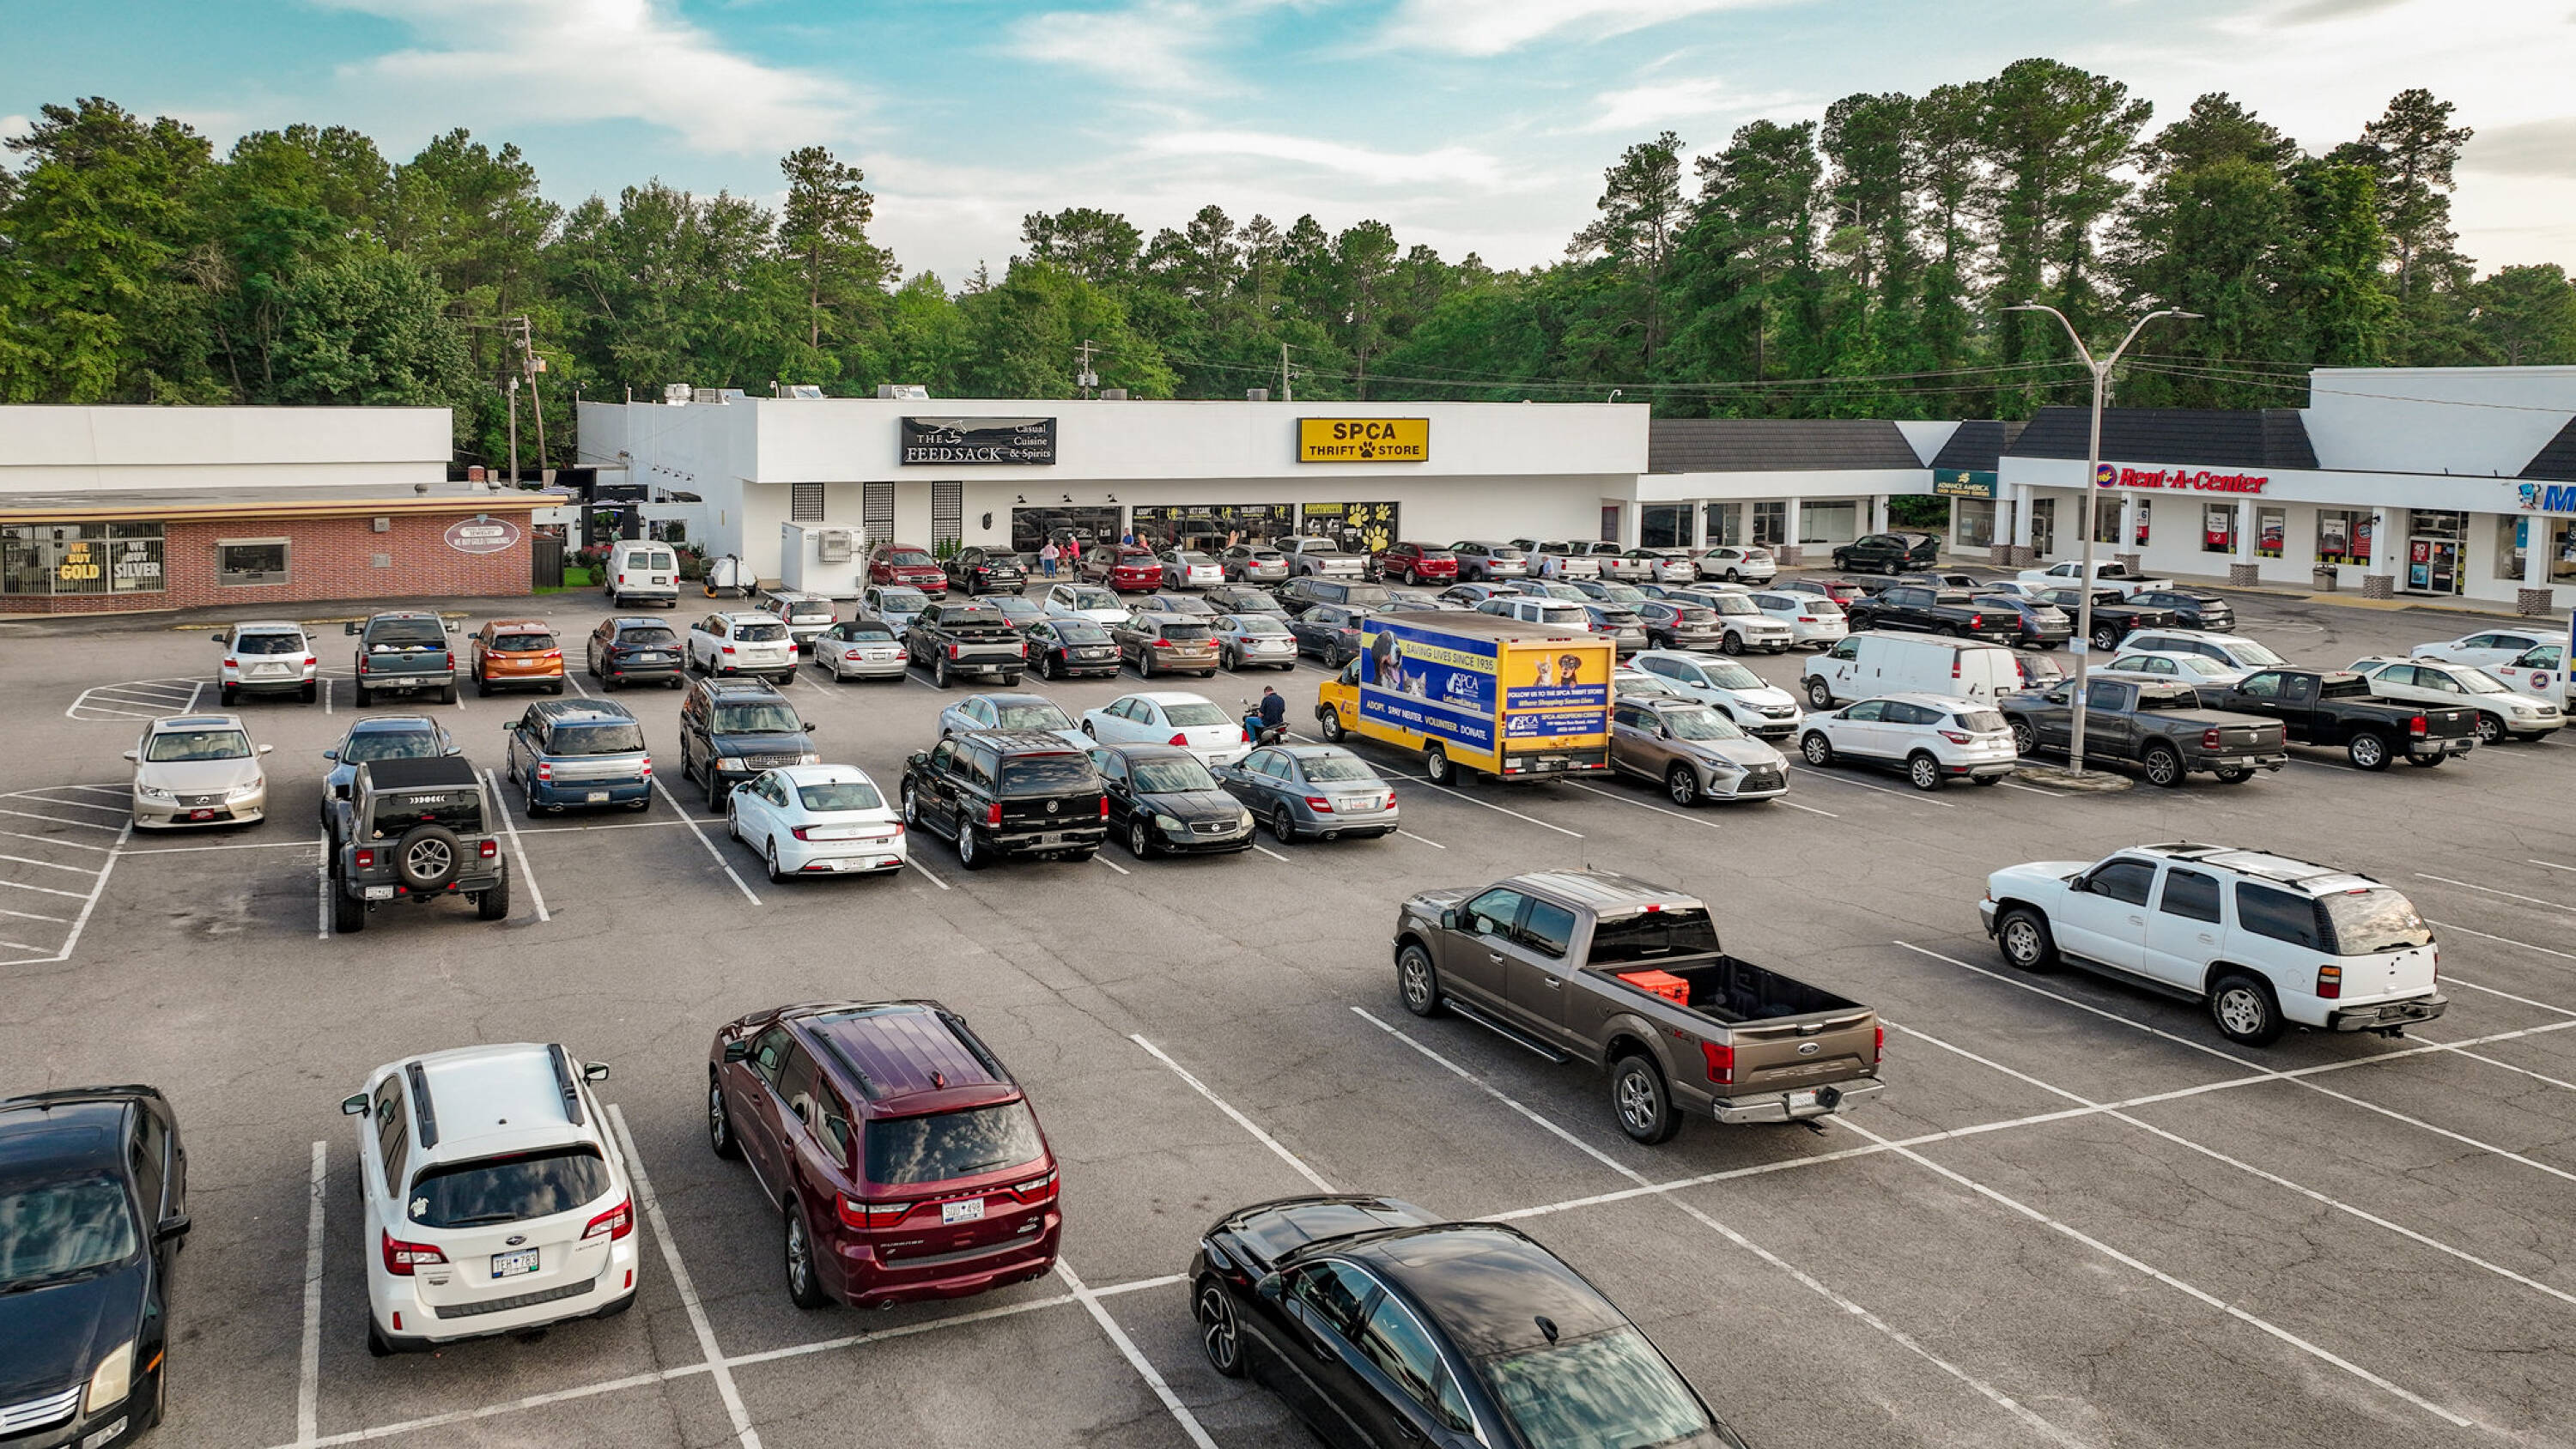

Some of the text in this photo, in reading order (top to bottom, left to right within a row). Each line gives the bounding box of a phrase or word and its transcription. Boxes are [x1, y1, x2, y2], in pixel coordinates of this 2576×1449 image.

[1016, 423, 1046, 433] Casual
[1334, 422, 1396, 440] SPCA
[916, 434, 943, 444] THE
[1014, 436, 1048, 446] Cuisine
[907, 447, 1003, 461] FEED SACK
[1009, 448, 1051, 459] & Spirits
[1309, 446, 1419, 456] THRIFT STORE
[70, 543, 88, 553] WE
[128, 542, 147, 551] WE
[68, 554, 91, 563] BUY
[126, 552, 149, 561] BUY
[60, 564, 100, 579] GOLD
[114, 562, 161, 578] SILVER
[1406, 644, 1494, 670] SAVING LIVES SINCE 1935
[1455, 673, 1479, 690] SPCA
[1518, 716, 1538, 724] SPCA
